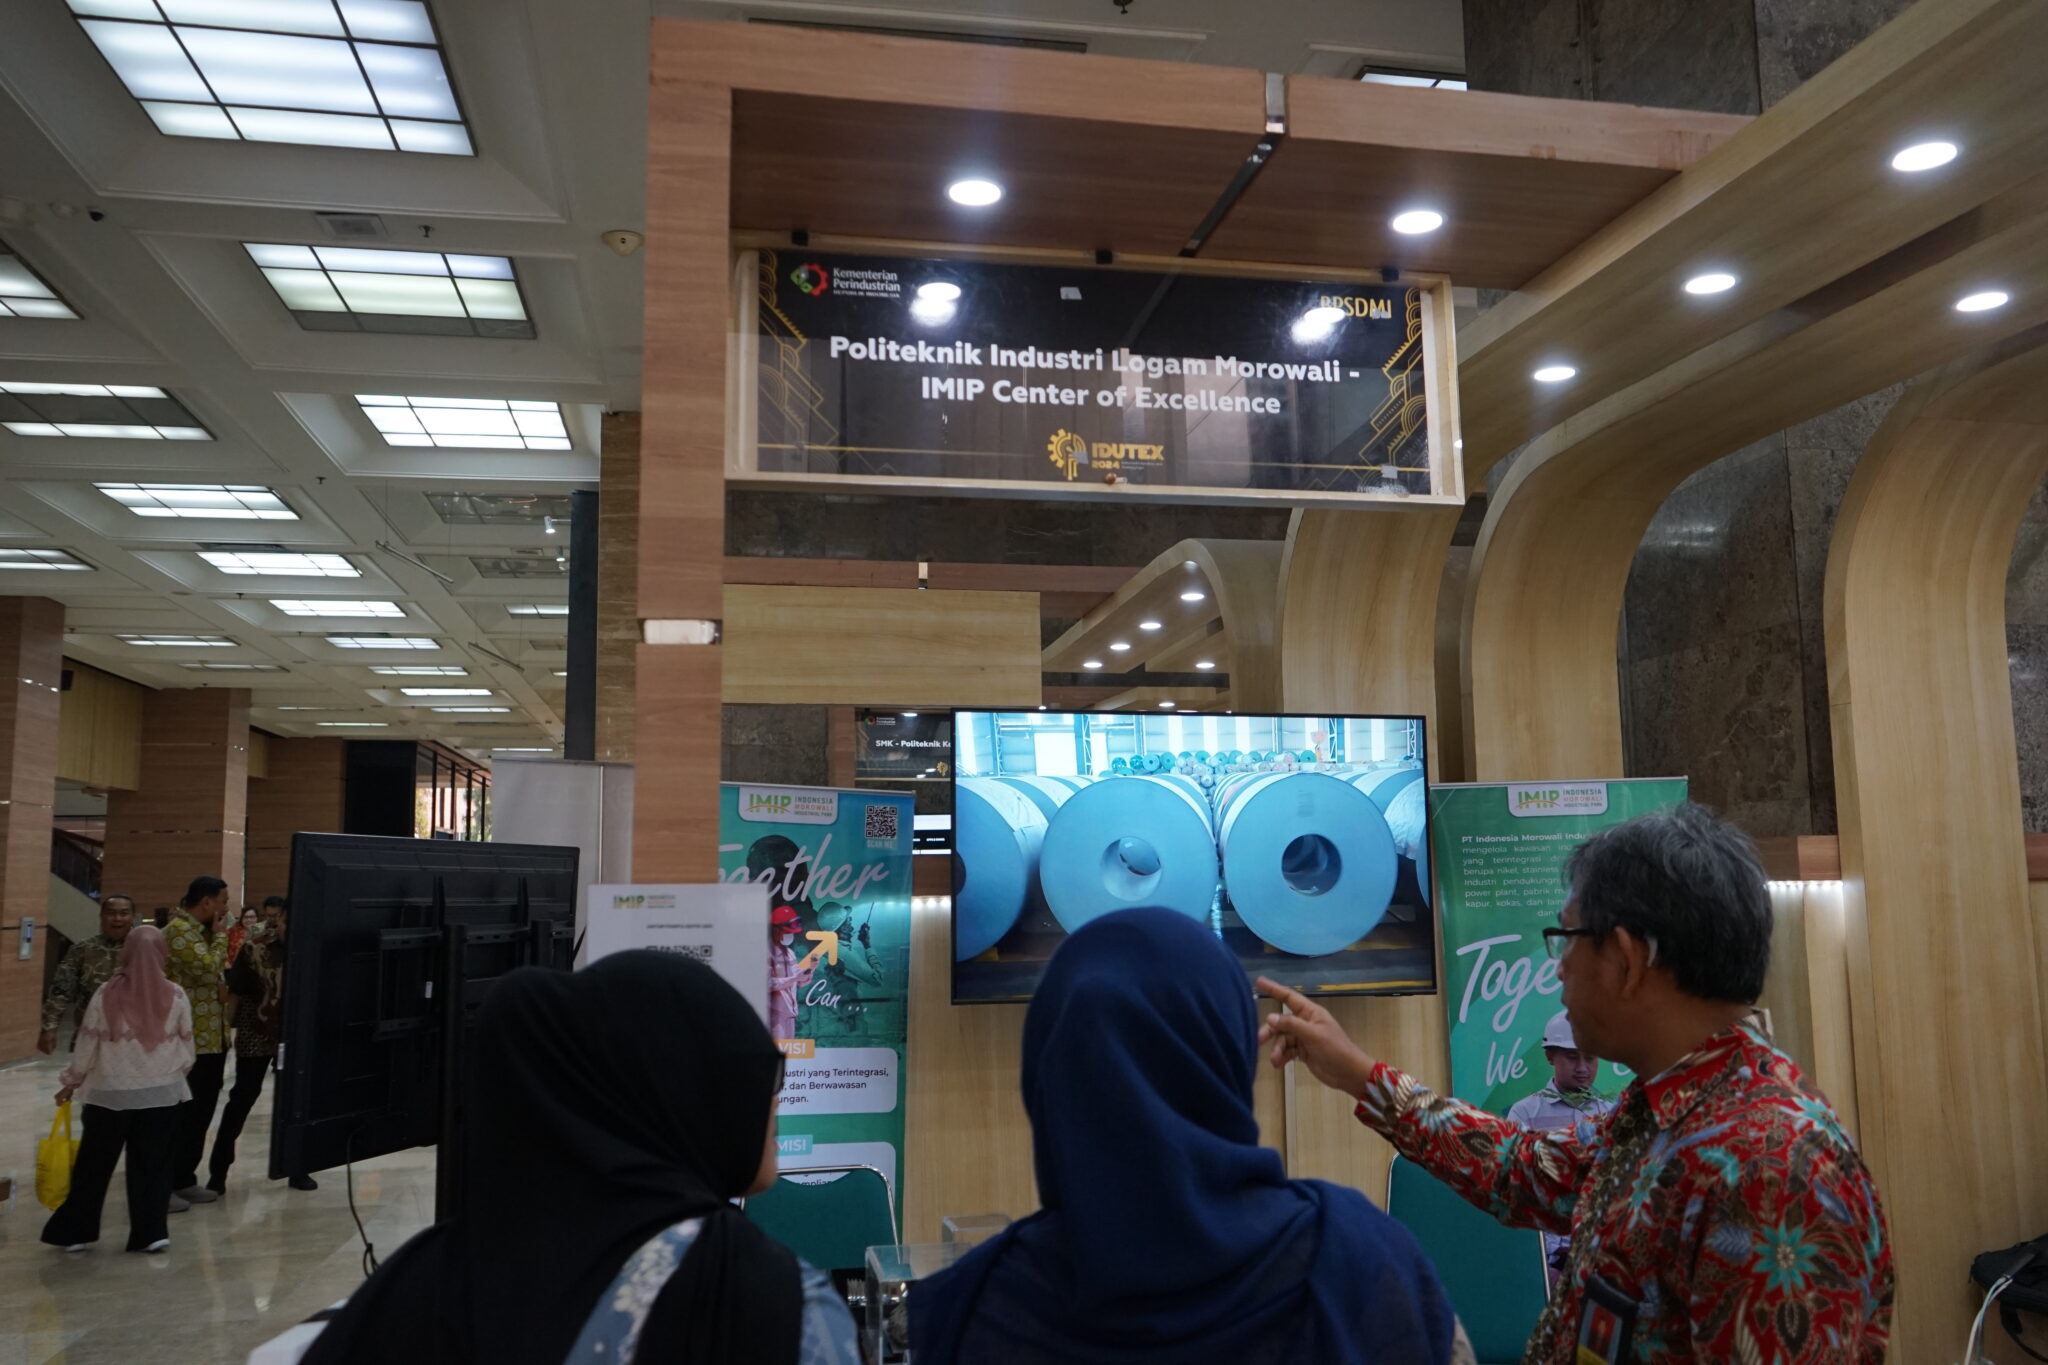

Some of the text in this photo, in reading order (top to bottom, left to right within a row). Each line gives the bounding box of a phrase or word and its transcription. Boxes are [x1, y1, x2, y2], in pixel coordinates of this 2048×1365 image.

[833, 268, 898, 281] Kementerian
[833, 278, 901, 292] Perindustrian
[830, 335, 983, 366] Politeknik
[990, 344, 1103, 371] Industri
[1112, 349, 1207, 379] Logam
[1215, 355, 1340, 383] Morowali
[921, 376, 1281, 414] IMIP Center of Excellence
[1091, 442, 1165, 461] IDUTEX
[1091, 460, 1120, 469] 2024
[900, 739, 941, 748] Politeknik
[1562, 788, 1602, 796] INDONESIA
[749, 793, 792, 814] IMIP
[794, 796, 833, 804] INDONESIA
[1517, 789, 1560, 809] IMIP
[1476, 835, 1519, 843] Indonesia
[1521, 833, 1562, 841] Morowali
[1565, 832, 1586, 840] Indu
[1462, 858, 1484, 866] yang
[1463, 868, 1494, 876] berupa
[1523, 888, 1550, 896] pabrik
[1526, 898, 1543, 906] dan
[1536, 909, 1554, 917] dan
[1456, 934, 1563, 1033] Toge
[778, 1042, 806, 1055] VISI
[1485, 1036, 1529, 1087] We
[785, 1067, 889, 1078] ustri yang Terintegrasi,
[789, 1082, 807, 1090] dan
[809, 1081, 867, 1090] Berwawasan
[777, 1094, 809, 1104] ungan.
[775, 1138, 806, 1152] MISI
